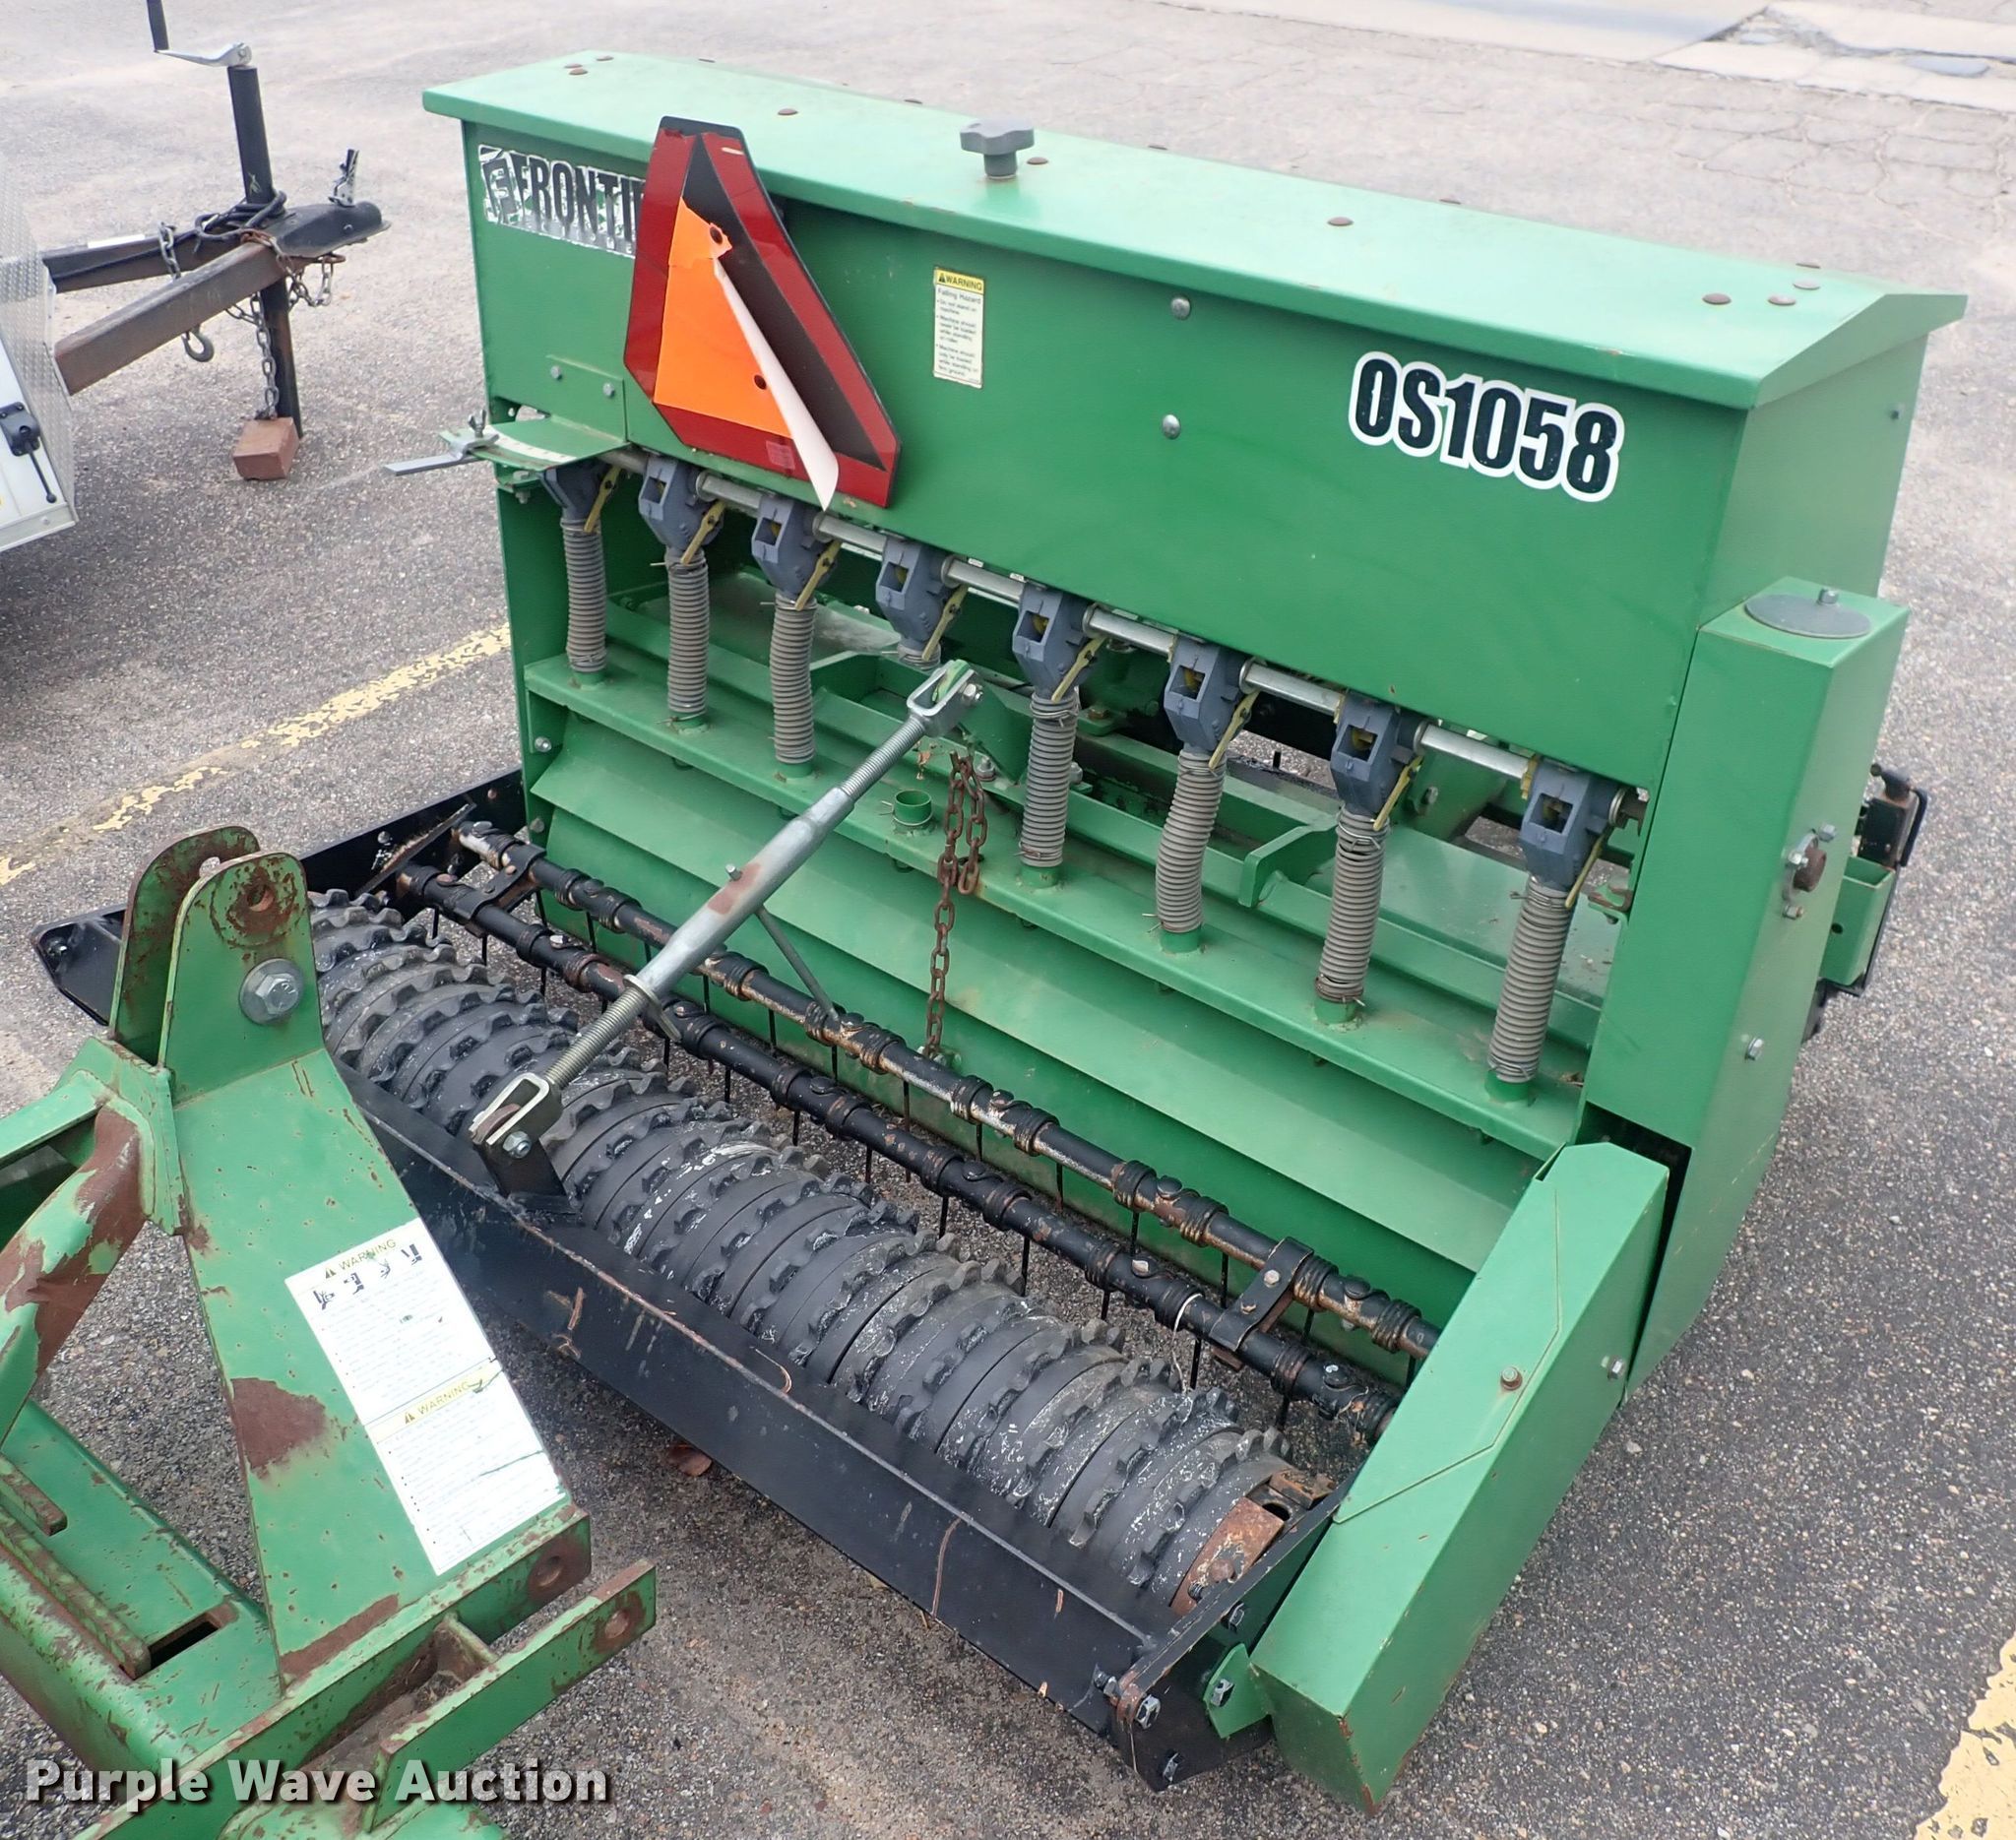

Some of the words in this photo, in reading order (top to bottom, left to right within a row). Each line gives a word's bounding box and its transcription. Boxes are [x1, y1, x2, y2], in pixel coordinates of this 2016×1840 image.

[946, 275, 982, 291] WARNING
[1352, 355, 1620, 498] OS1058
[338, 1237, 398, 1272] WARNING
[417, 1379, 471, 1416] WARNING
